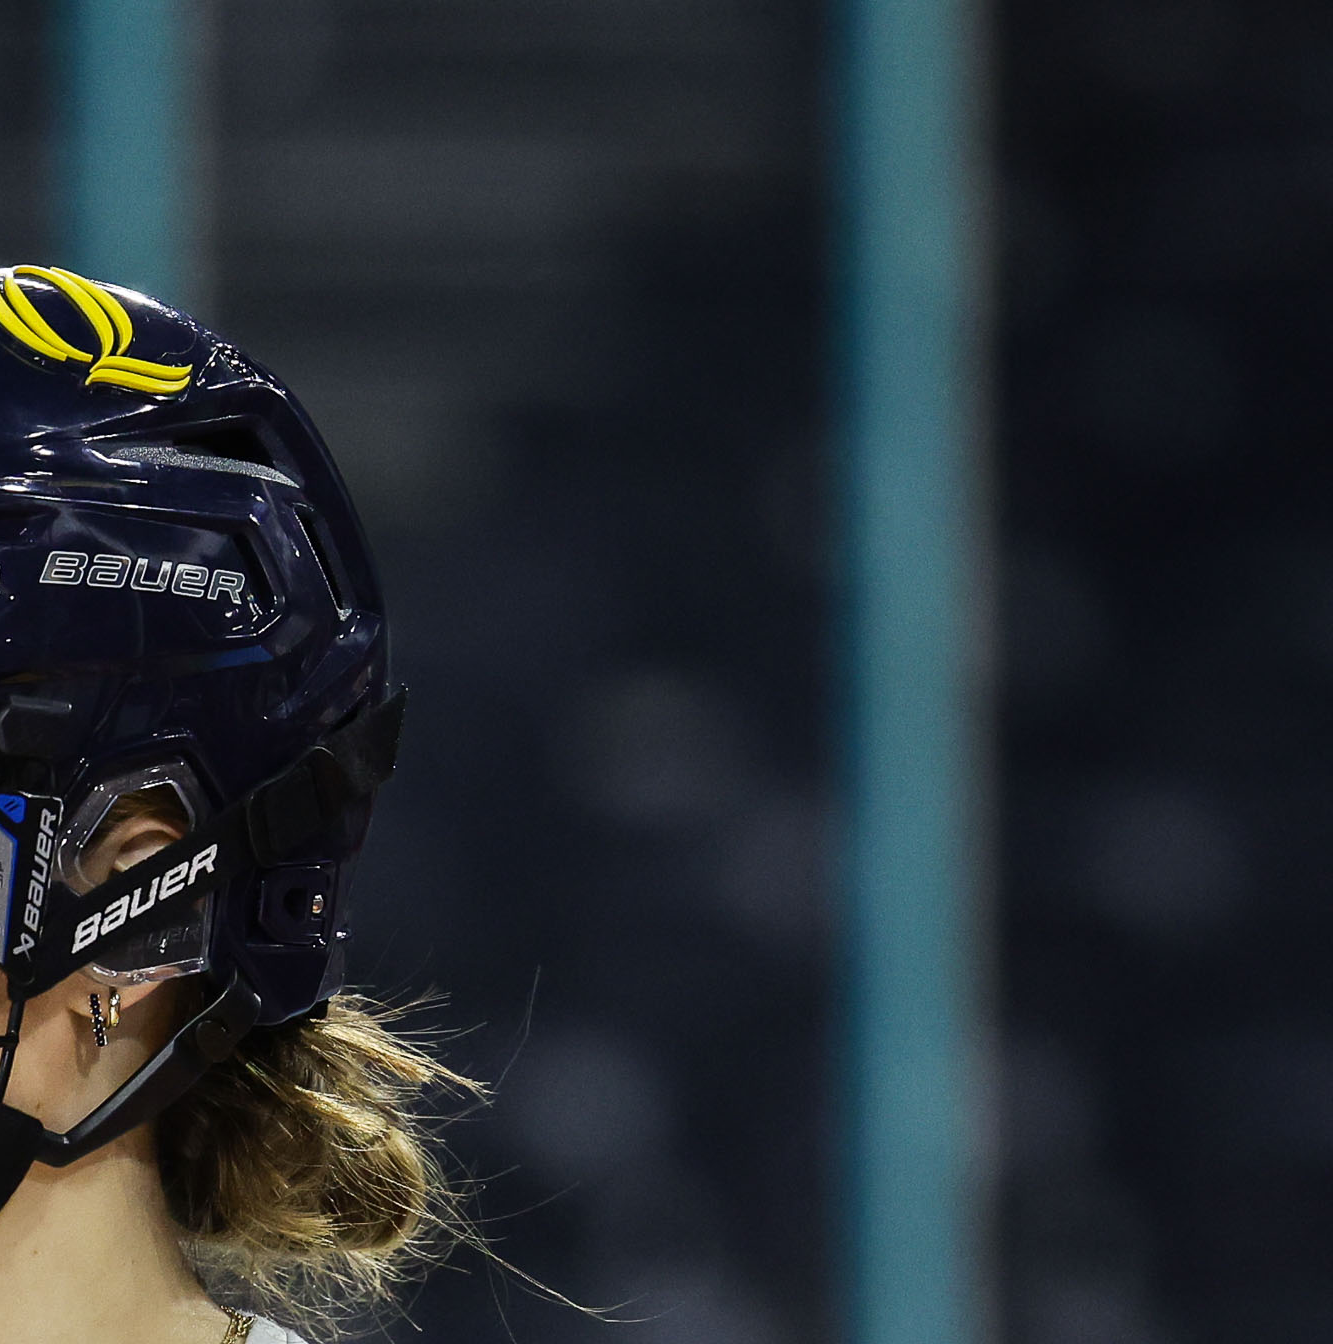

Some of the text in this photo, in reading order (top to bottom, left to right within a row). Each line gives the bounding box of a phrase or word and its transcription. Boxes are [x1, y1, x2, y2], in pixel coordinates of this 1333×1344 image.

[39, 550, 245, 604] BAUER
[24, 808, 57, 933] BAUER
[71, 843, 218, 954] BAUER
